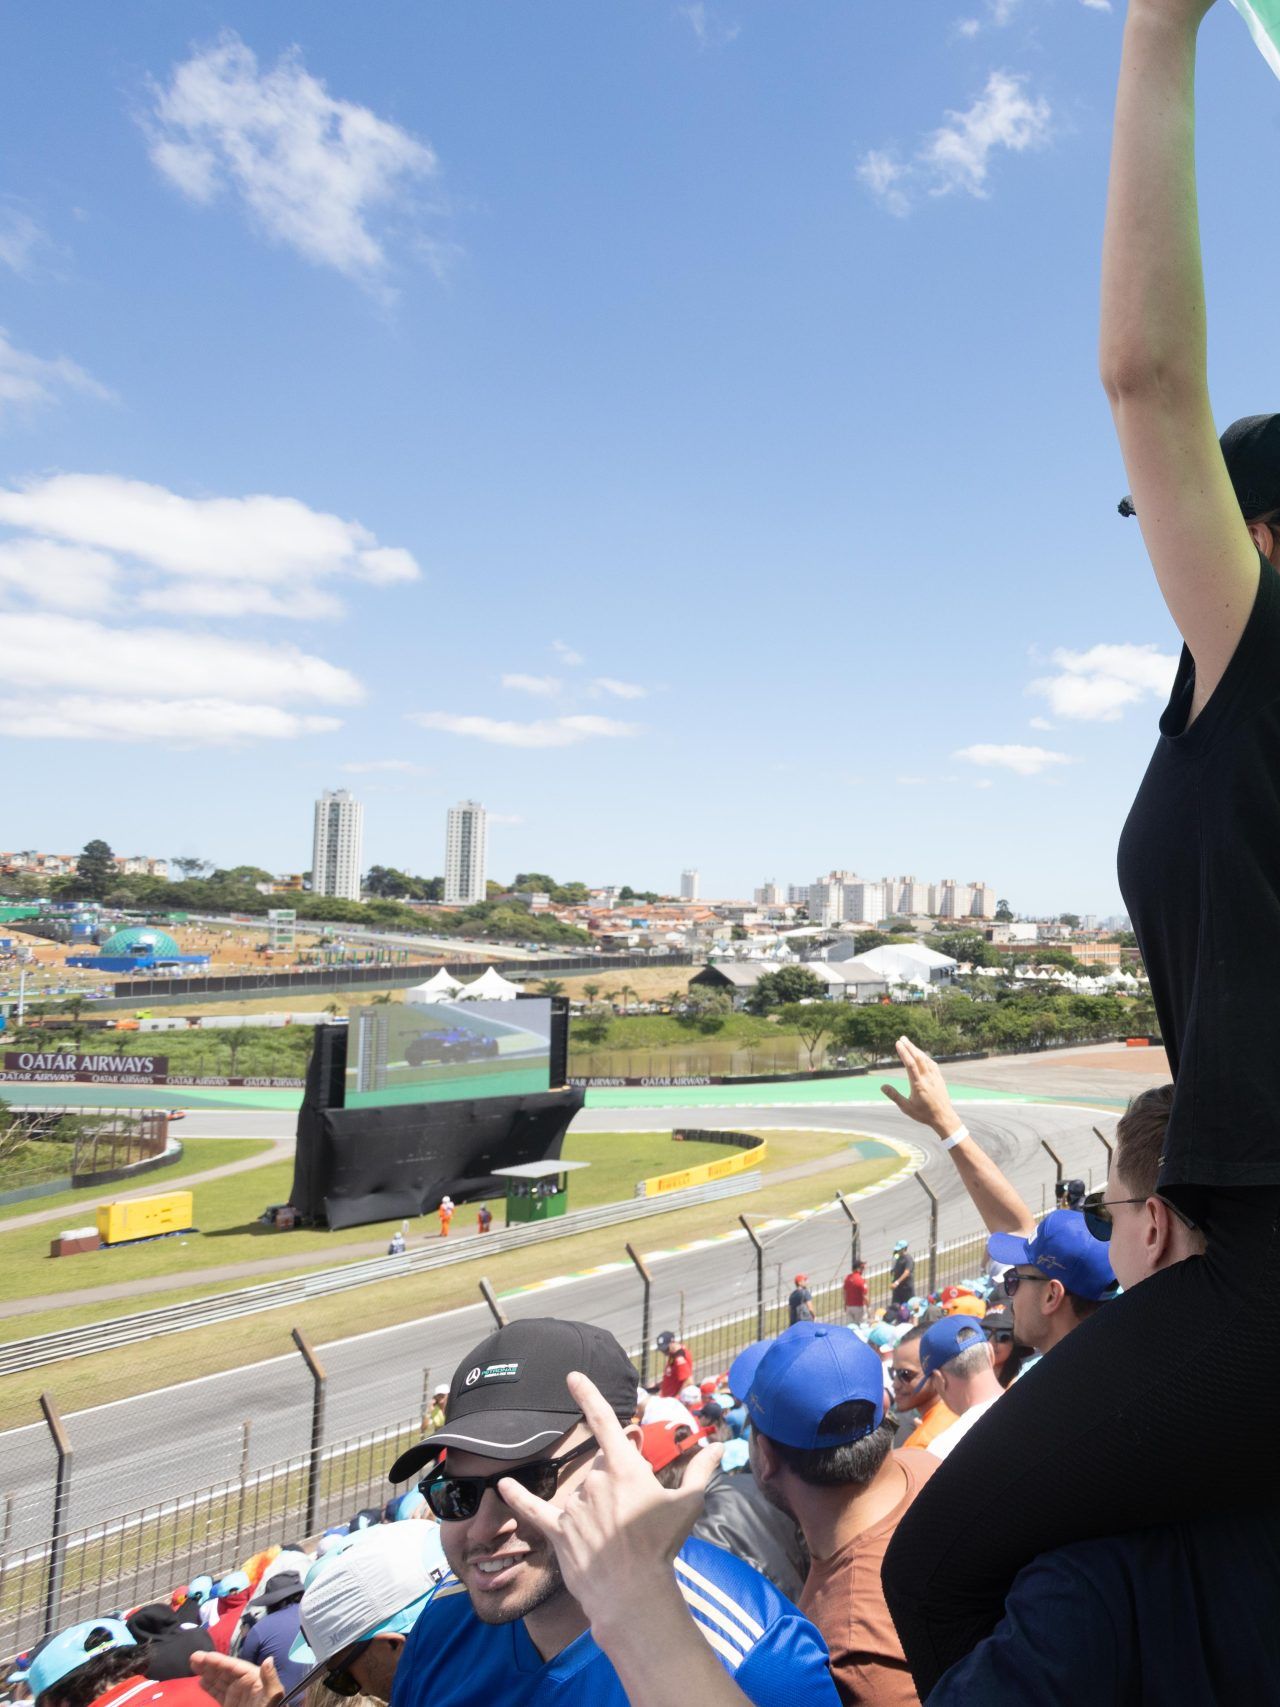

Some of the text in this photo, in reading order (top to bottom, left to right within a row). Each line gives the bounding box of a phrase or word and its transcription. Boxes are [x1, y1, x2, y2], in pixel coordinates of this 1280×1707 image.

[18, 1053, 154, 1073] QATAR AIRWAYS
[0, 1072, 76, 1082] QATAR AIRWAYS
[92, 1074, 154, 1084] QATAR AIRWAYS
[166, 1076, 229, 1086] QATAR AIRWAYS
[588, 1078, 627, 1086] AIRWAYS
[641, 1076, 711, 1086] QATAR AIRWAYS
[243, 1078, 270, 1087] QATAR
